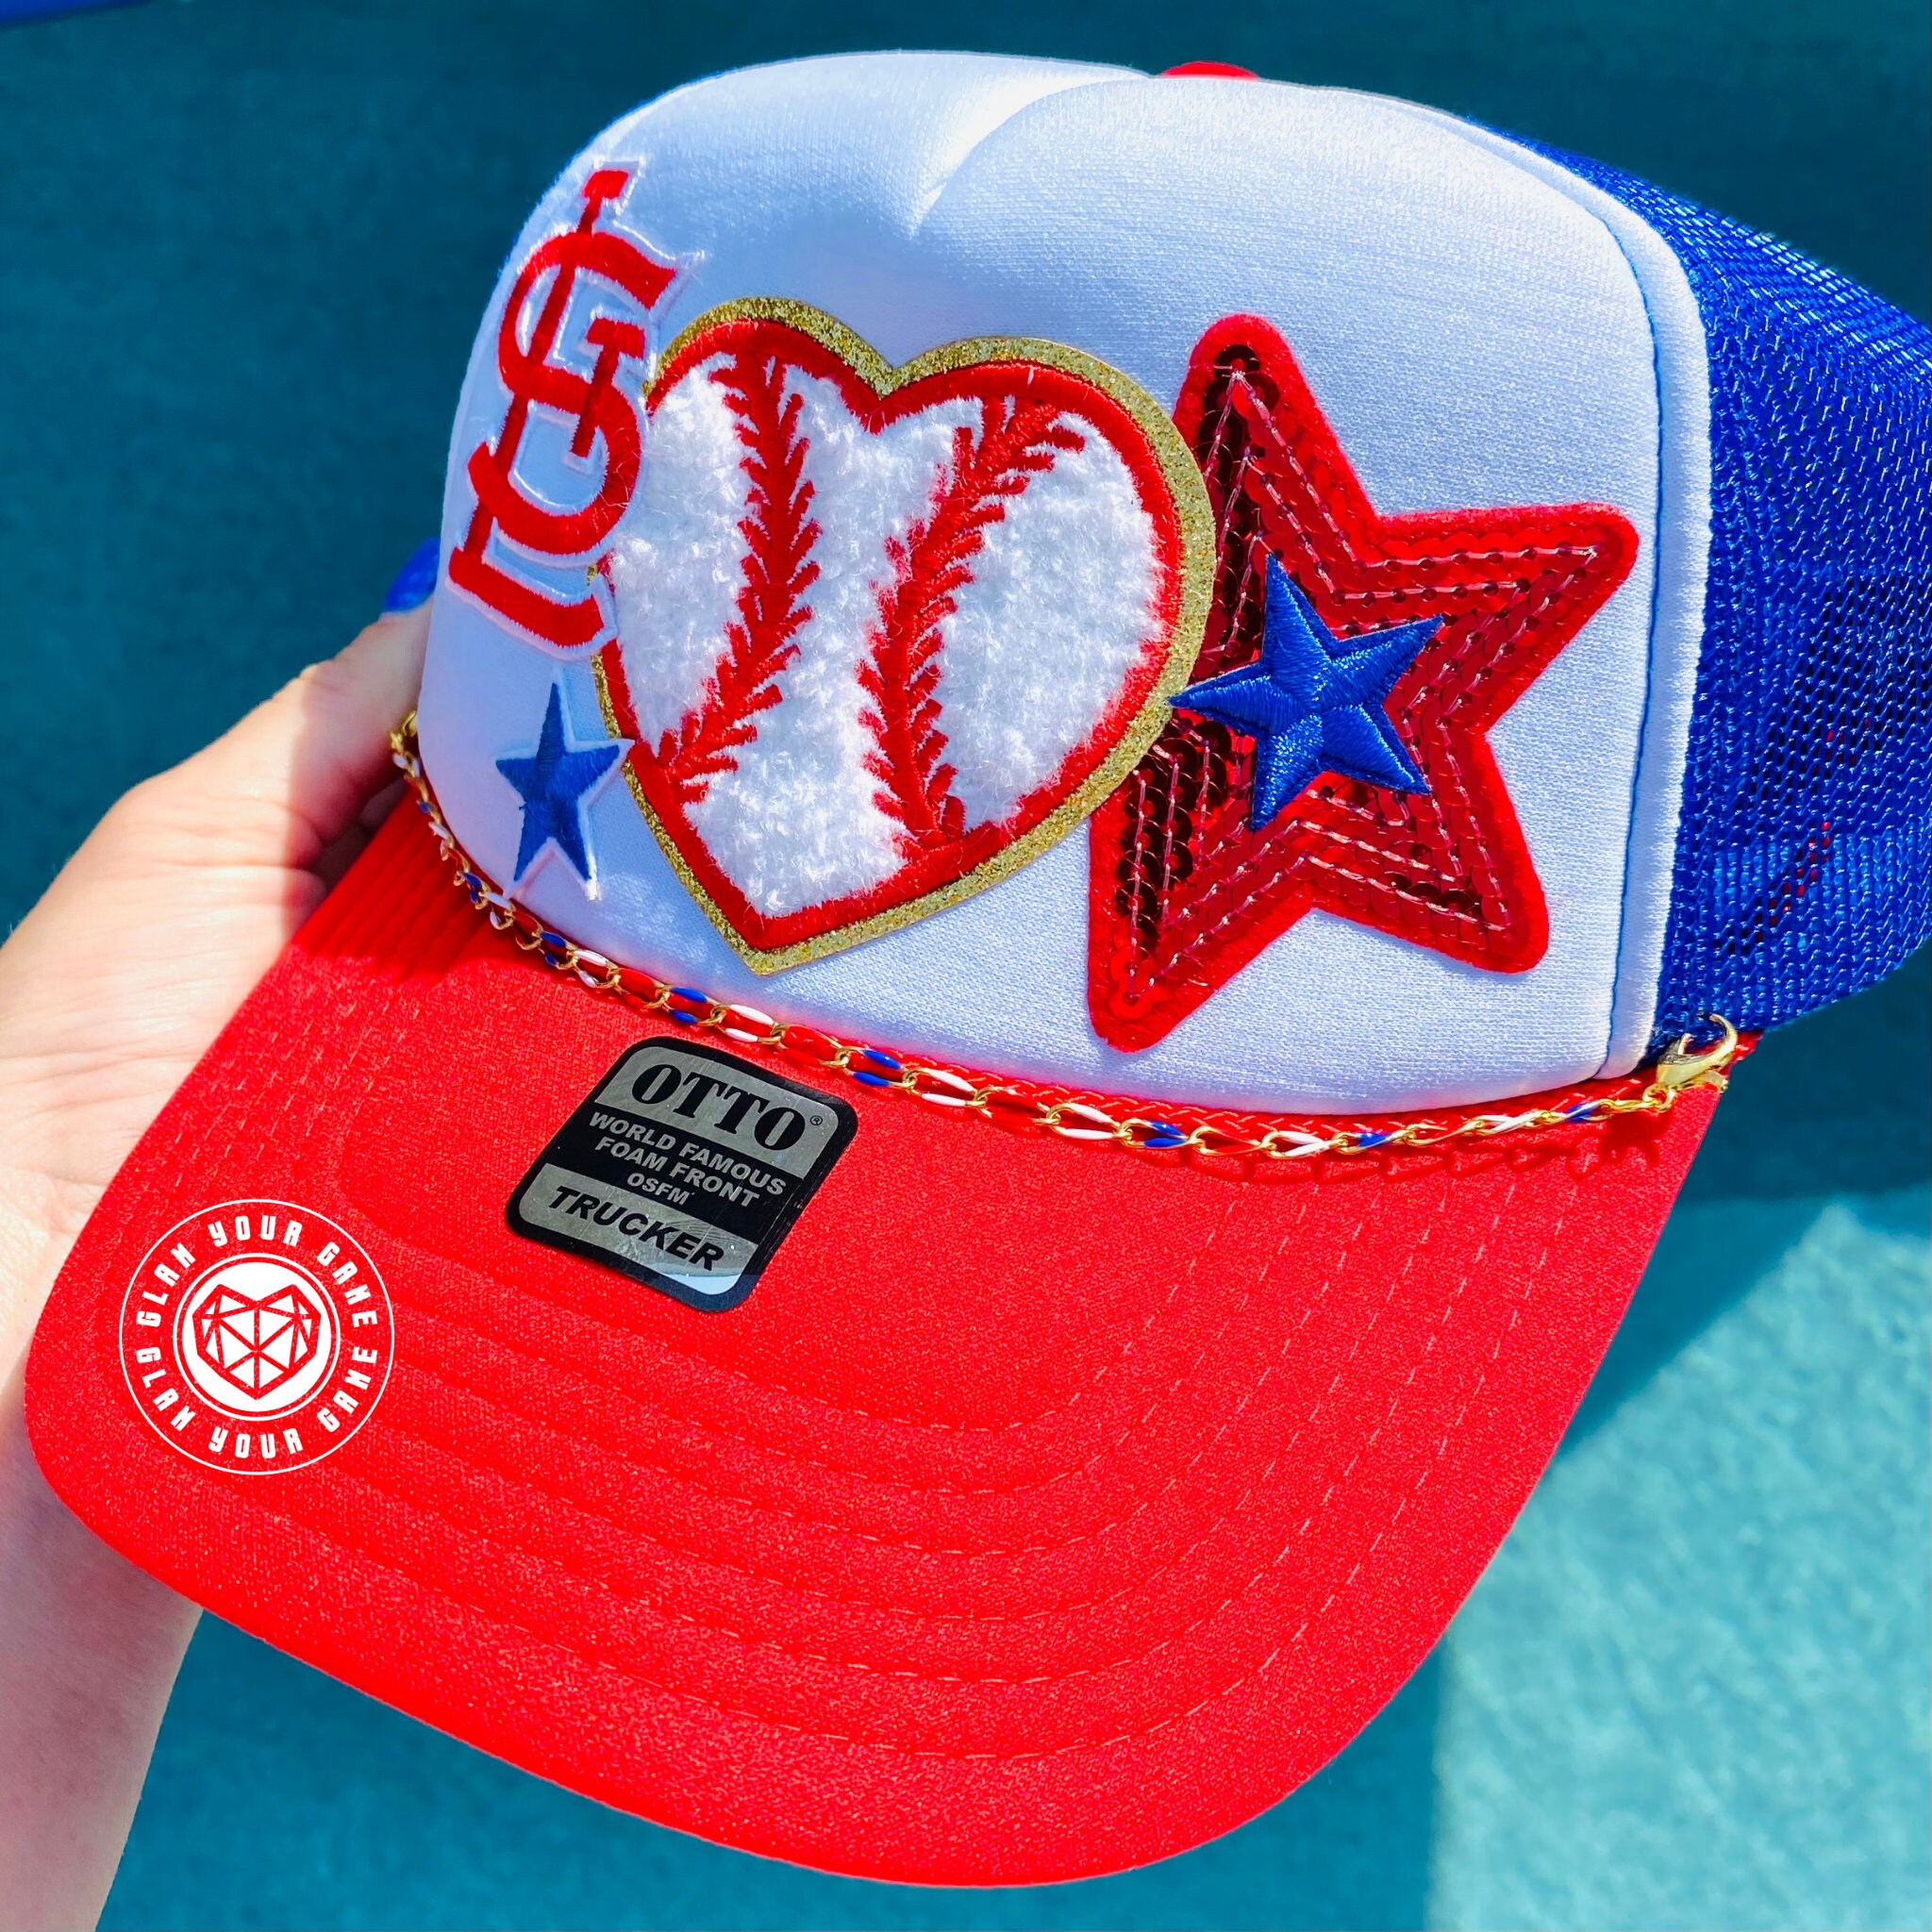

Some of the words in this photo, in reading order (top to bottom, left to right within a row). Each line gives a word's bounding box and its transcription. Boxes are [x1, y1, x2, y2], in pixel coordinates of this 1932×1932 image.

[631, 1064, 806, 1151] OTTO
[589, 1111, 676, 1151] WORLD
[679, 1142, 787, 1195] FAMOUS
[594, 1138, 667, 1171] FOAM
[669, 1163, 760, 1207] FRONT
[548, 1186, 724, 1271] TRUCKER
